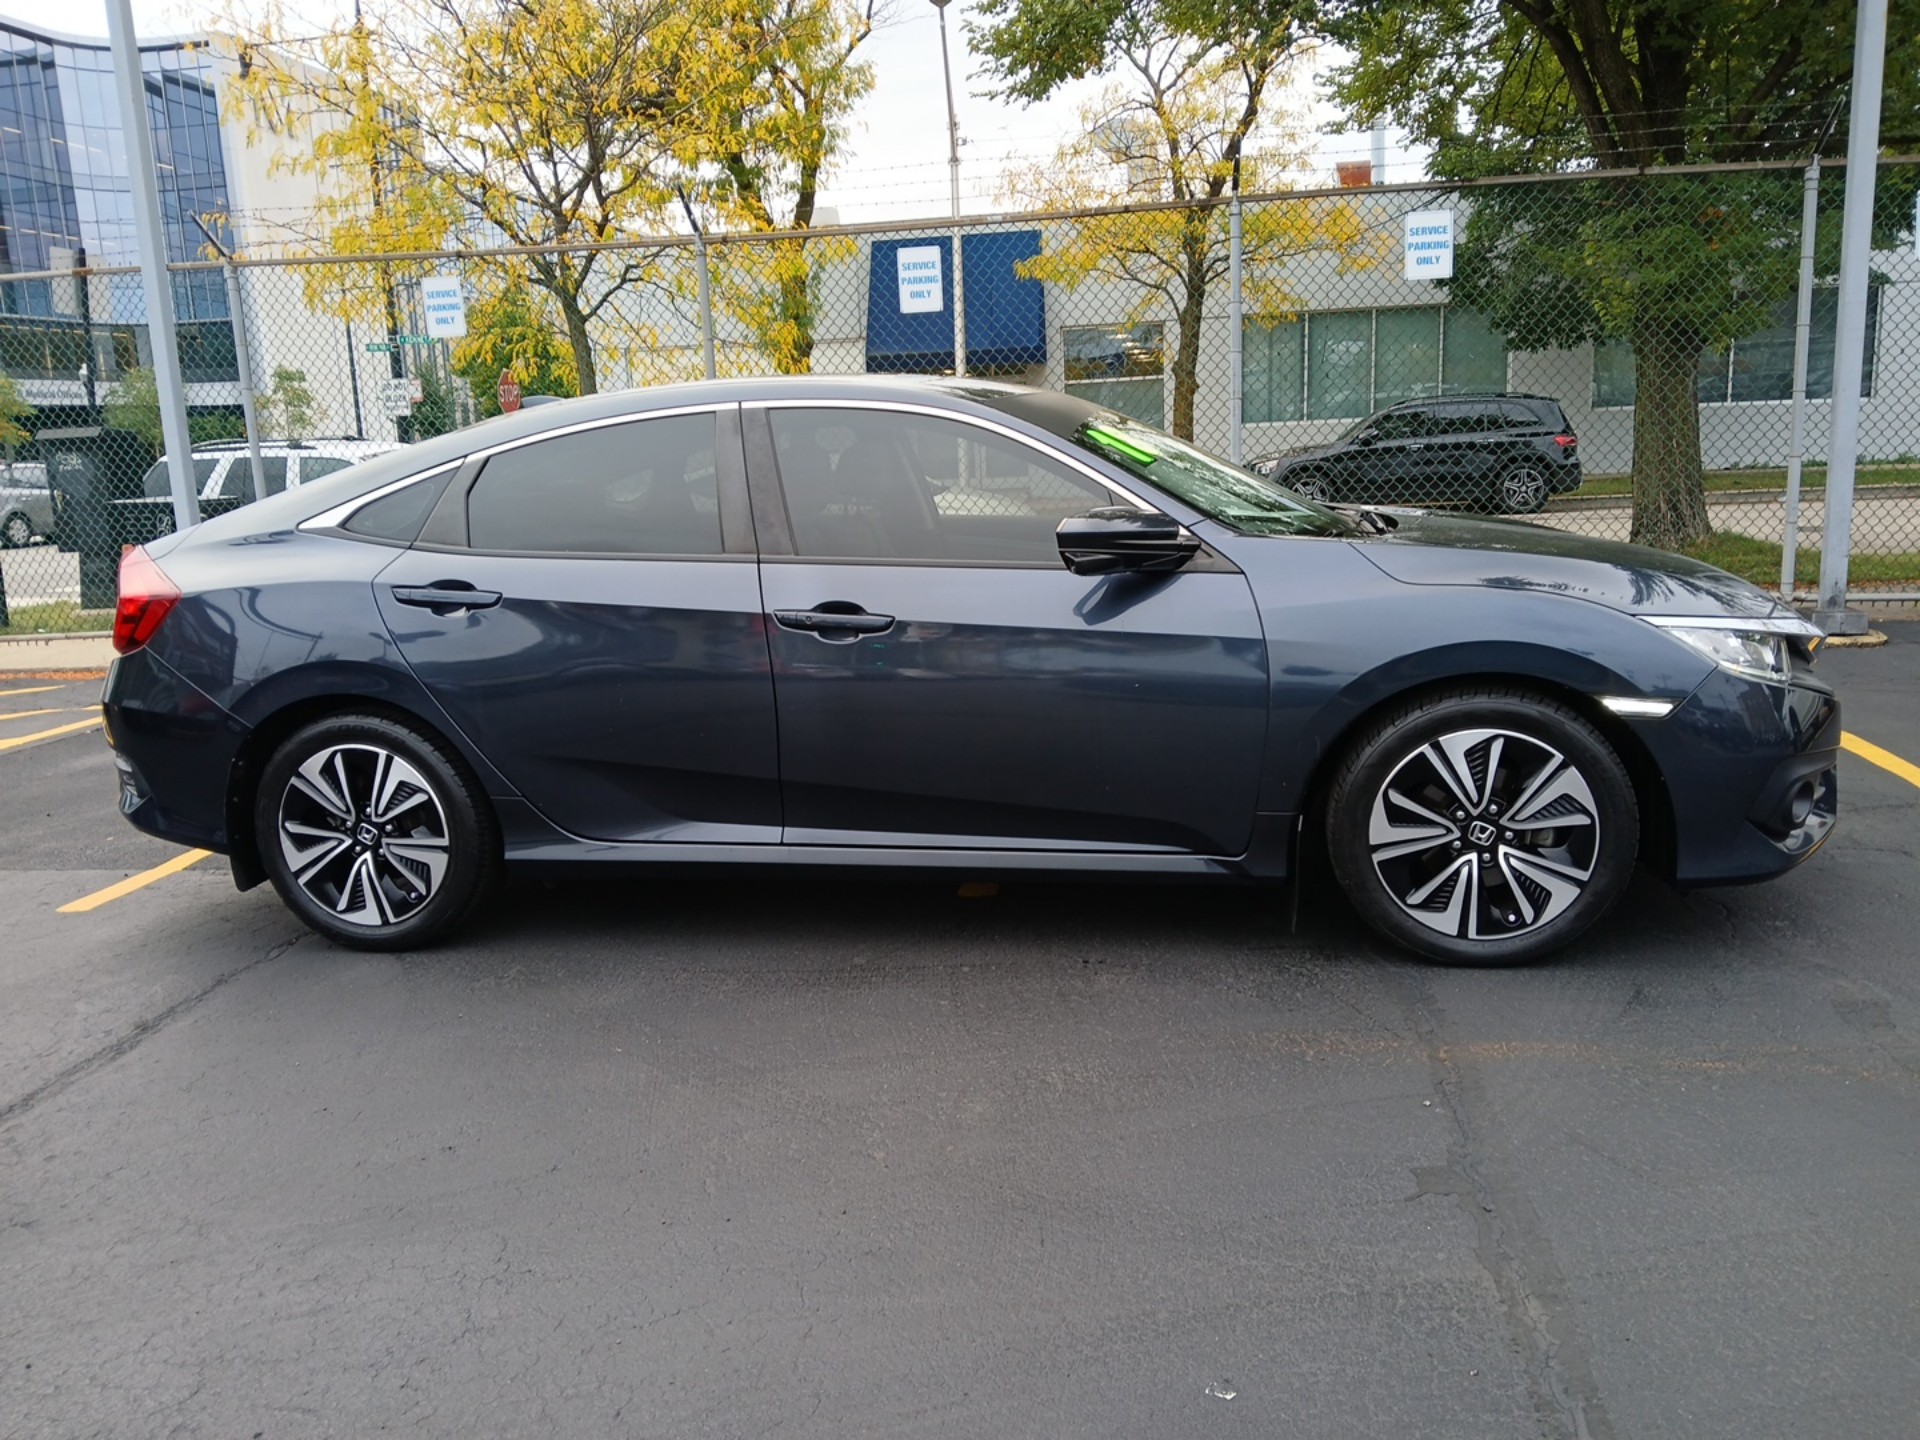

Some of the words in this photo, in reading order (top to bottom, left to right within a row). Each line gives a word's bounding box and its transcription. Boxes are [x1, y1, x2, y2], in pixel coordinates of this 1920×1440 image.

[1409, 225, 1448, 236] SERVICE
[1408, 240, 1449, 251] PARKING
[1416, 255, 1441, 266] ONLY
[901, 261, 937, 271] SERVICE
[901, 275, 939, 285] PARKING
[426, 290, 457, 299] SERVICE
[910, 290, 932, 299] ONLY
[426, 303, 461, 312] PARKING
[435, 316, 455, 325] ONLY
[500, 384, 519, 402] STOP
